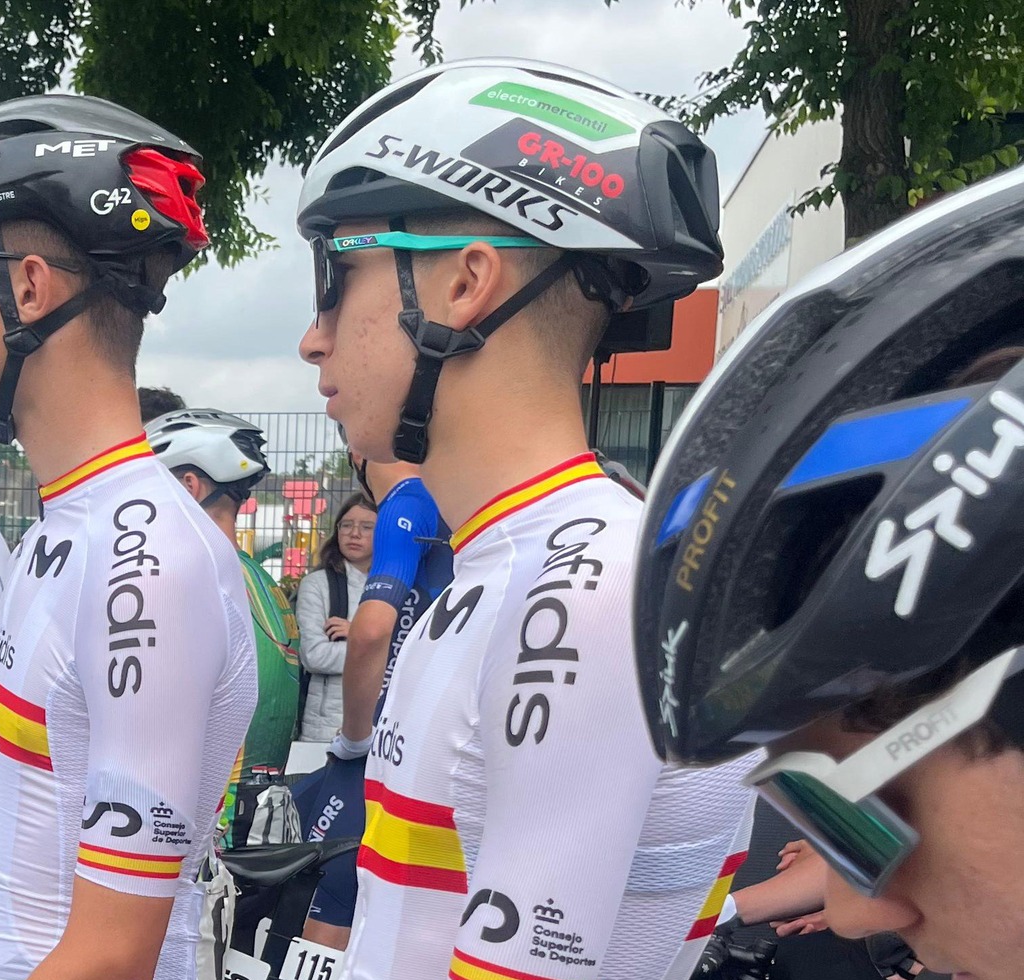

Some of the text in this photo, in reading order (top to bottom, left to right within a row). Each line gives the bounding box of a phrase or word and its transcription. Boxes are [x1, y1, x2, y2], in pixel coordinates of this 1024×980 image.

[486, 87, 610, 134] electromercantil
[35, 139, 117, 158] MET
[516, 131, 625, 199] GR-100
[365, 133, 579, 232] S-WORKS
[518, 157, 604, 207] BIKES
[342, 237, 373, 247] OAKLEY
[676, 469, 738, 592] PROFIT
[106, 498, 160, 698] Cofidis
[505, 517, 607, 747] Cofidis
[885, 704, 961, 763] PROFIT
[152, 835, 163, 843] de
[153, 820, 186, 831] Consejo
[153, 828, 187, 838] Superior
[531, 936, 584, 955] Superior
[533, 924, 582, 944] Consejo
[529, 947, 546, 958] de
